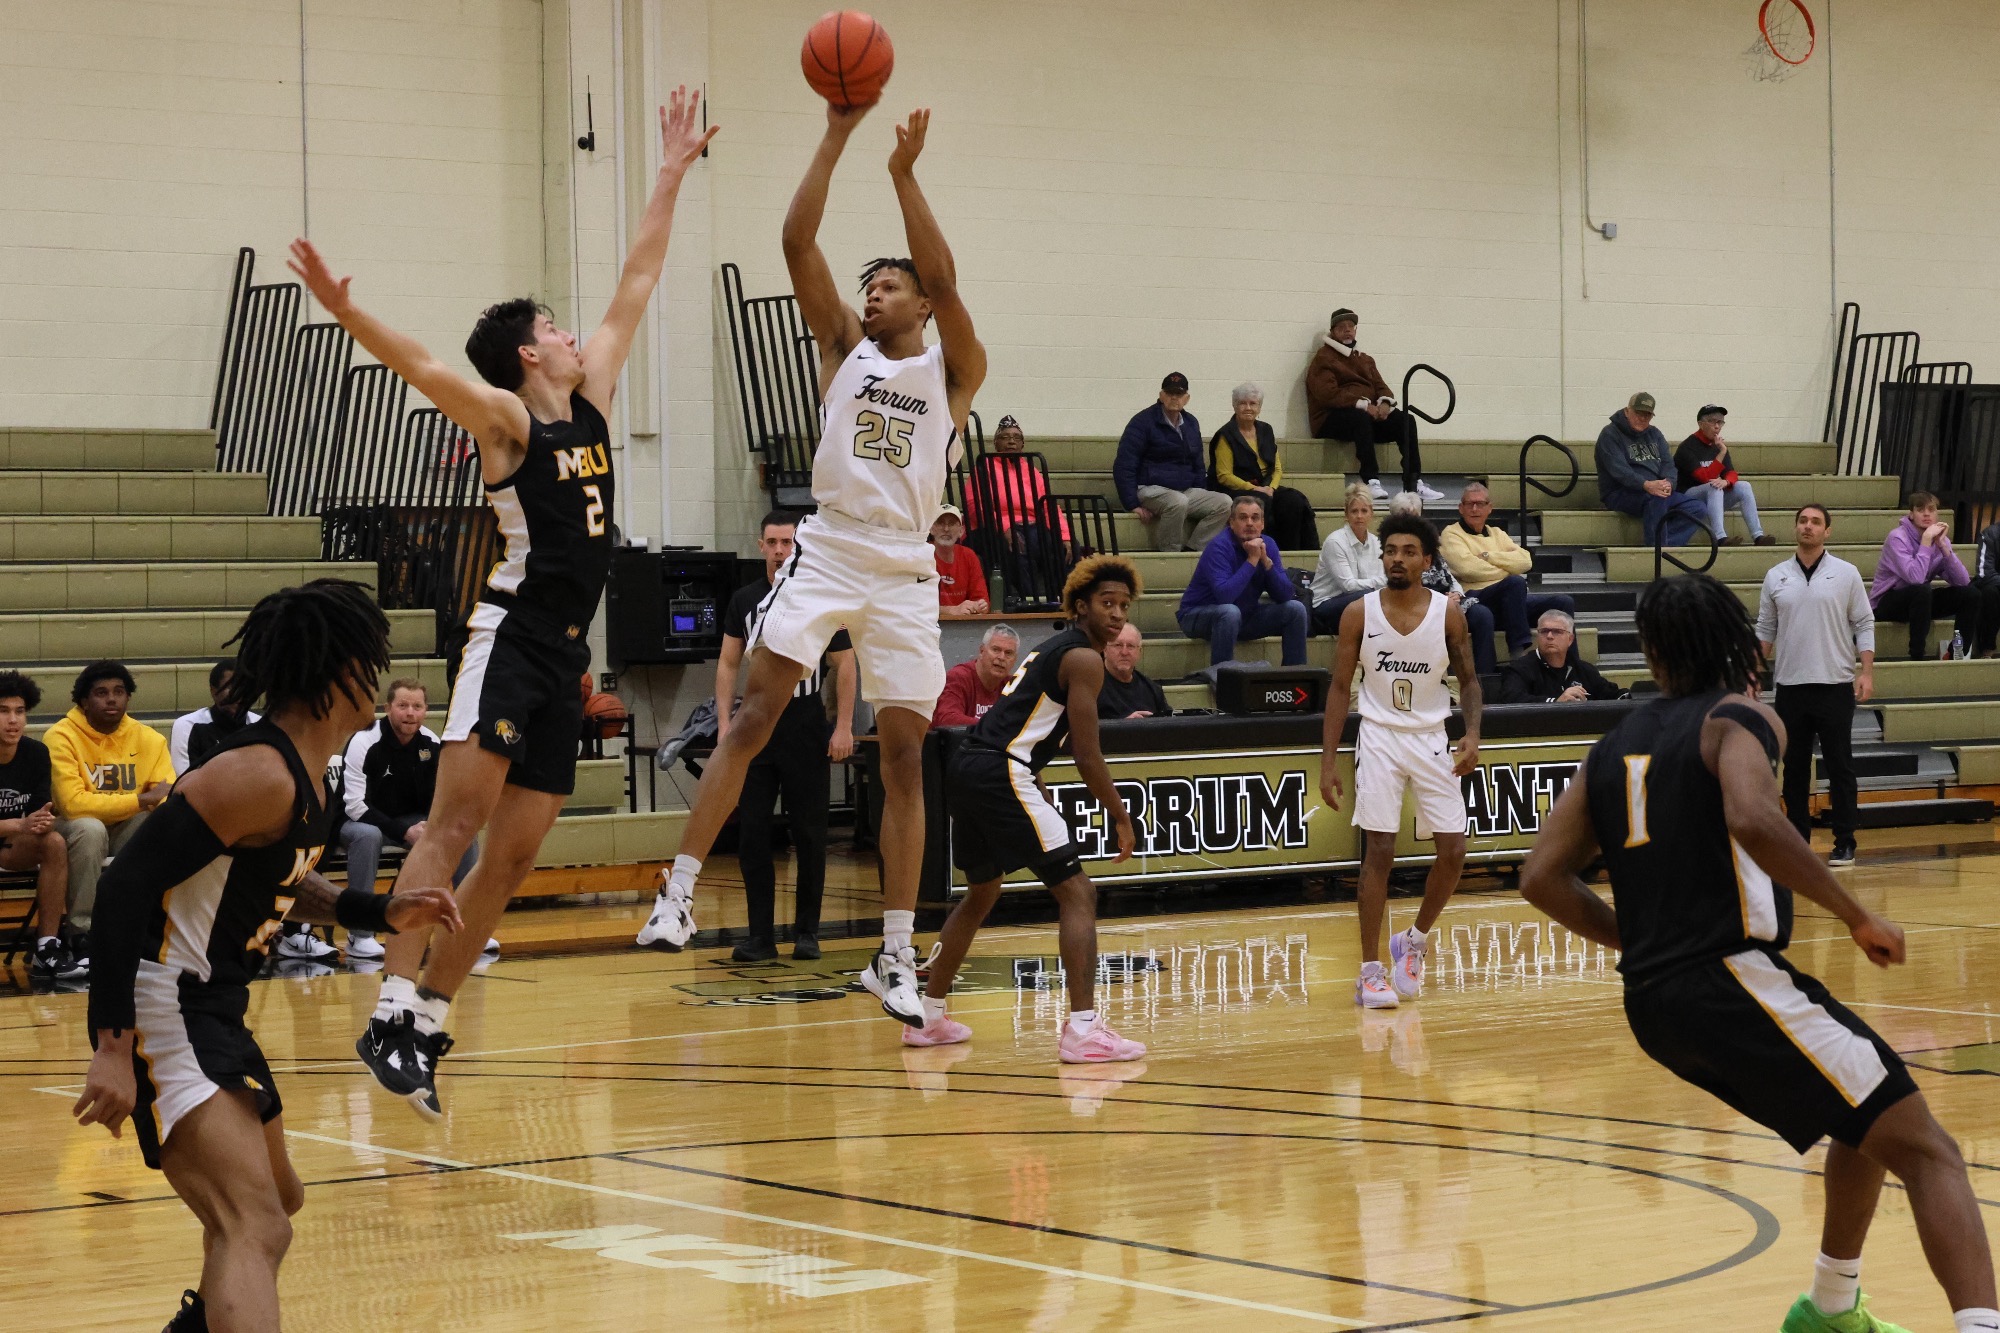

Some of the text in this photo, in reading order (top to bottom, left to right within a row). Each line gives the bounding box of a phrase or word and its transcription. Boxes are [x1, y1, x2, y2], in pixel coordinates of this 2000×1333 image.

[855, 374, 928, 415] Ferrum
[553, 442, 609, 481] MBU
[853, 409, 915, 468] 25
[582, 484, 605, 537] 2
[1375, 651, 1431, 674] Ferrum
[1391, 678, 1412, 711] 0
[1046, 771, 1308, 861] ERRUM
[1623, 753, 1652, 848] 1
[495, 1224, 935, 1298] NCAA
